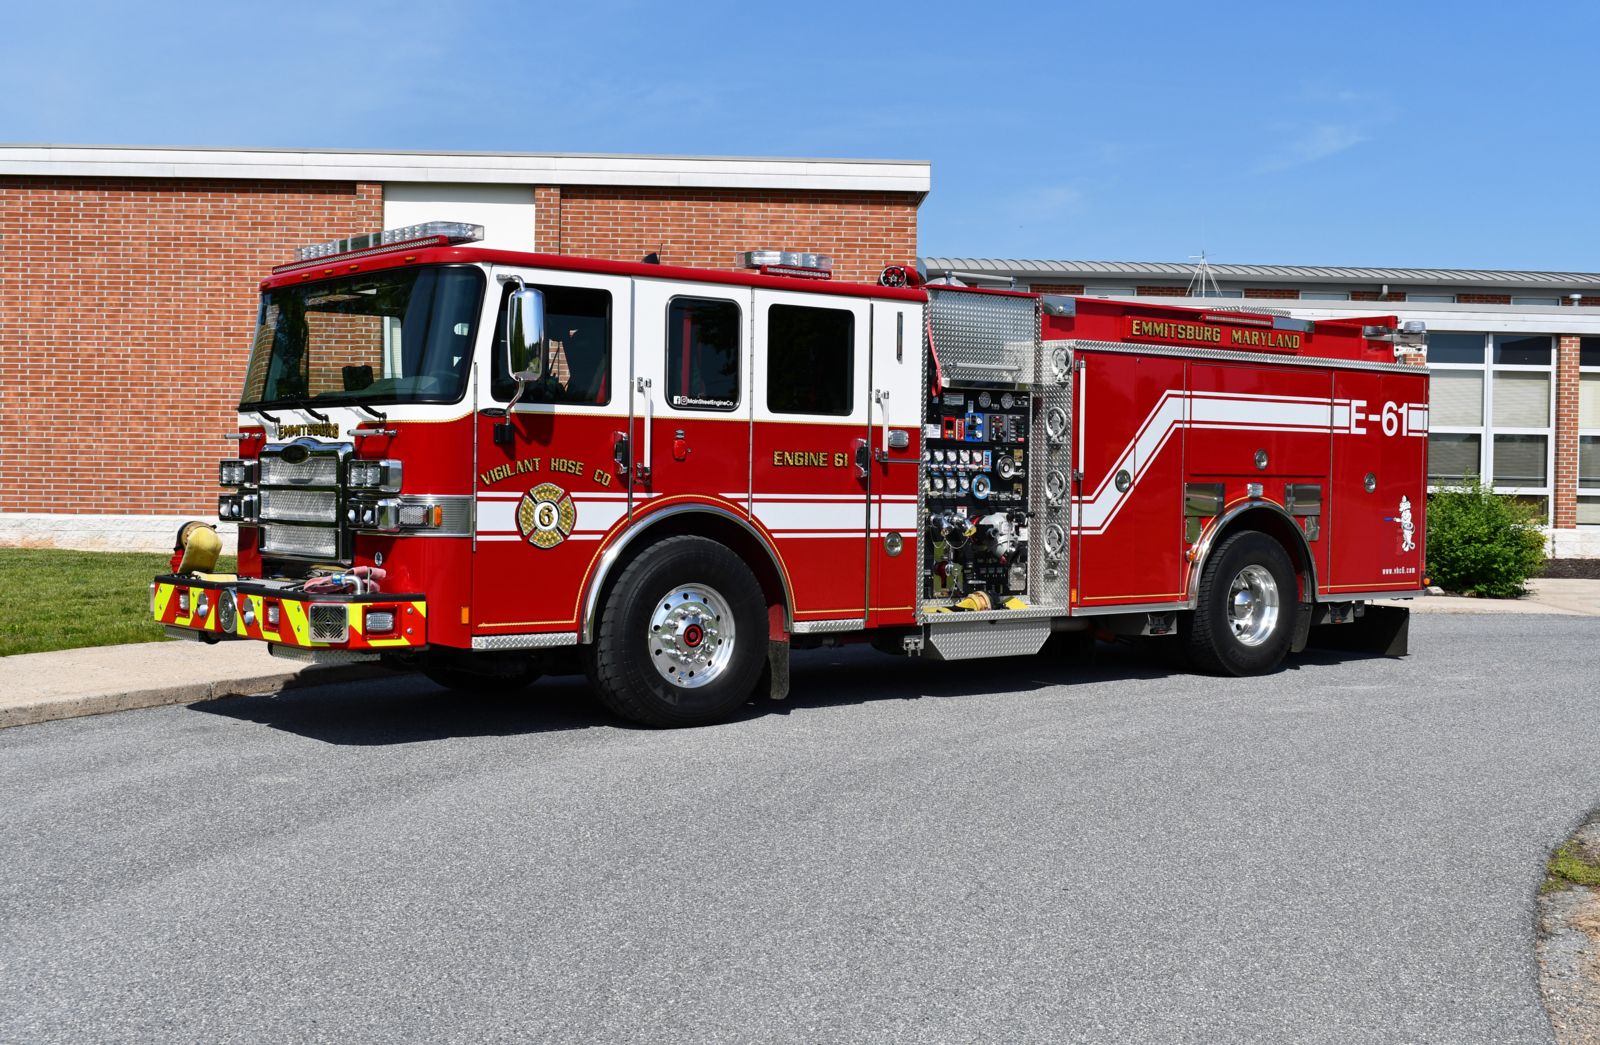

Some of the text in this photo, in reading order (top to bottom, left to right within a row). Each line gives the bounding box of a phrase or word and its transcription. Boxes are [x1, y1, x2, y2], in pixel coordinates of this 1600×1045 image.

[1131, 319, 1300, 349] EMMITSBURG MARYLAND
[1350, 399, 1408, 437] E-61
[278, 422, 340, 441] EMMITSBURG
[480, 457, 541, 486] VIGILANT
[550, 457, 585, 476] HOSE
[773, 450, 849, 468] ENGINE 61
[539, 504, 554, 527] 6
